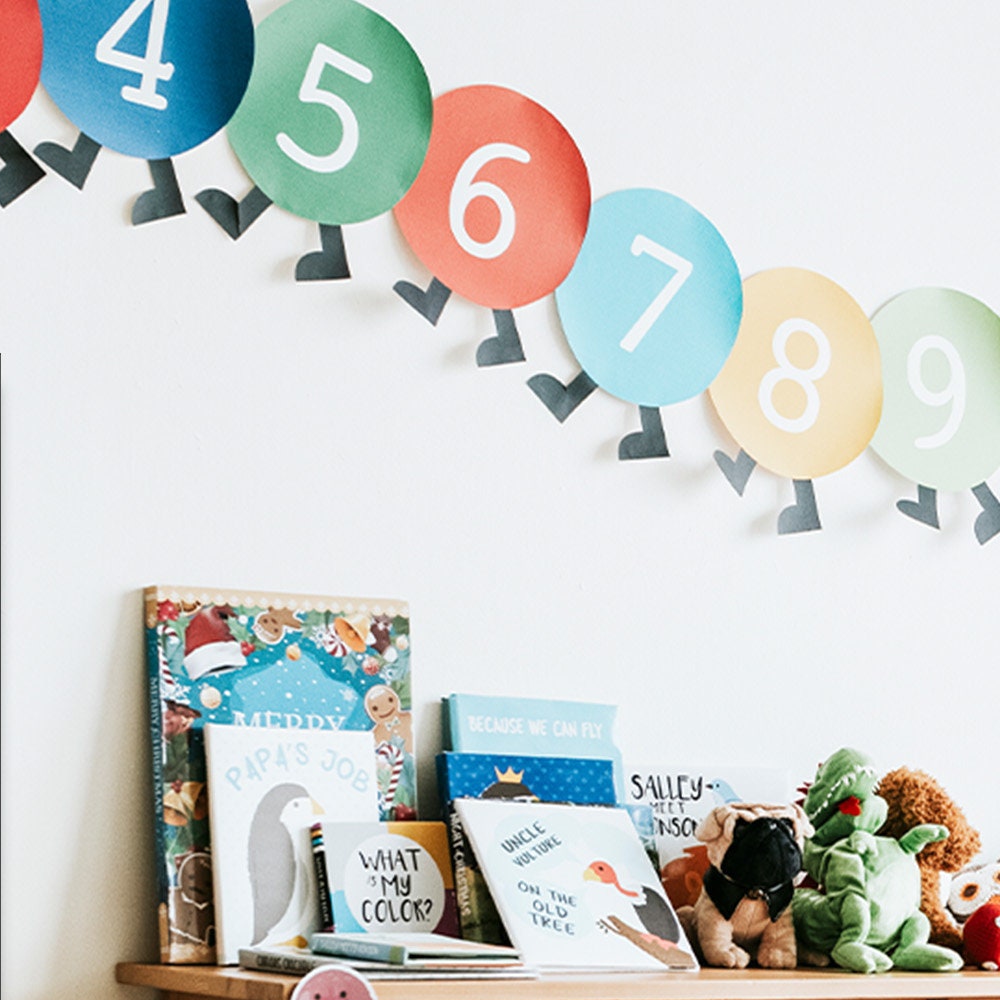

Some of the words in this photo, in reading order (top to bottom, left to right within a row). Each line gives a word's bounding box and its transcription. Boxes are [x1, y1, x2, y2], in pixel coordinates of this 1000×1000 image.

[96, 0, 175, 110] 4
[276, 43, 373, 173] 5
[449, 142, 531, 259] 6
[619, 234, 693, 353] 7
[758, 318, 832, 433] 8
[906, 335, 966, 449] 9
[149, 676, 161, 723] MERRY
[467, 714, 524, 735] BECAUSE
[528, 718, 548, 737] WE
[553, 720, 579, 739] CAN
[581, 721, 604, 740] FLY
[224, 741, 310, 791] PAPA'S
[320, 748, 371, 793] JOB
[630, 773, 703, 801] SALLEY
[649, 801, 686, 815] MEET
[501, 820, 547, 855] UNCLE
[512, 834, 563, 869] VULTURE
[358, 848, 422, 872] WHAT
[380, 874, 412, 898] MY
[517, 880, 541, 897] ON
[548, 888, 578, 908] THE
[361, 898, 433, 924] COLOR?
[528, 911, 576, 936] TREE
[532, 900, 569, 918] OLD
